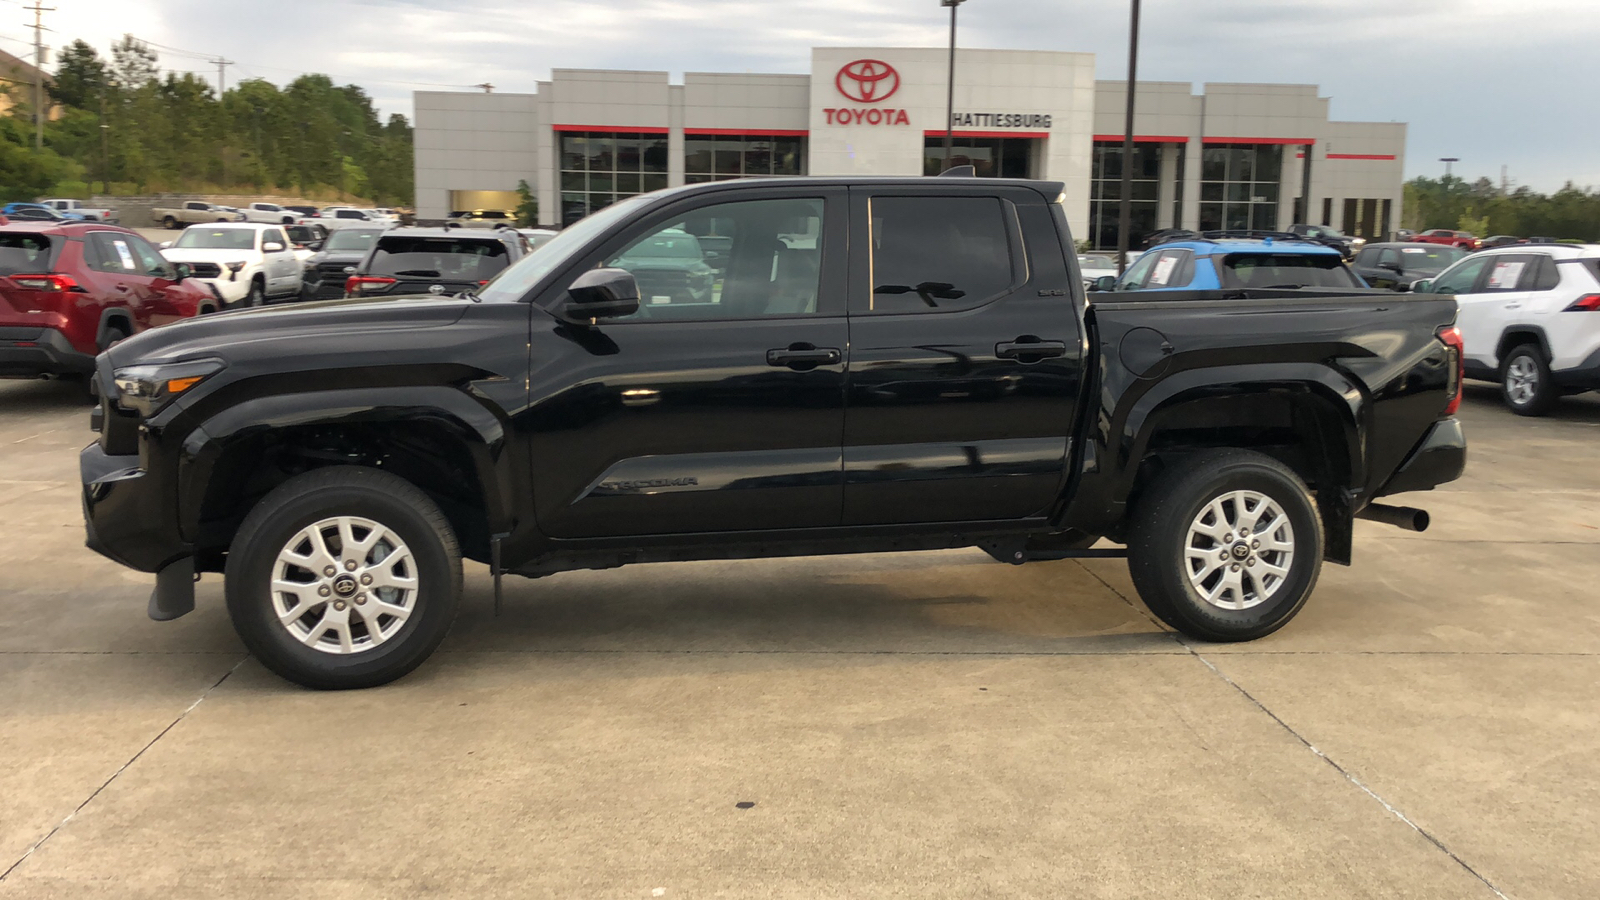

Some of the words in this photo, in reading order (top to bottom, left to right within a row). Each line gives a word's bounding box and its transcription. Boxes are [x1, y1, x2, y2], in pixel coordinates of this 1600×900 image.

[823, 108, 911, 126] TOYOTA
[952, 112, 1052, 128] HATTIESBURG
[600, 476, 699, 490] TACOMA
